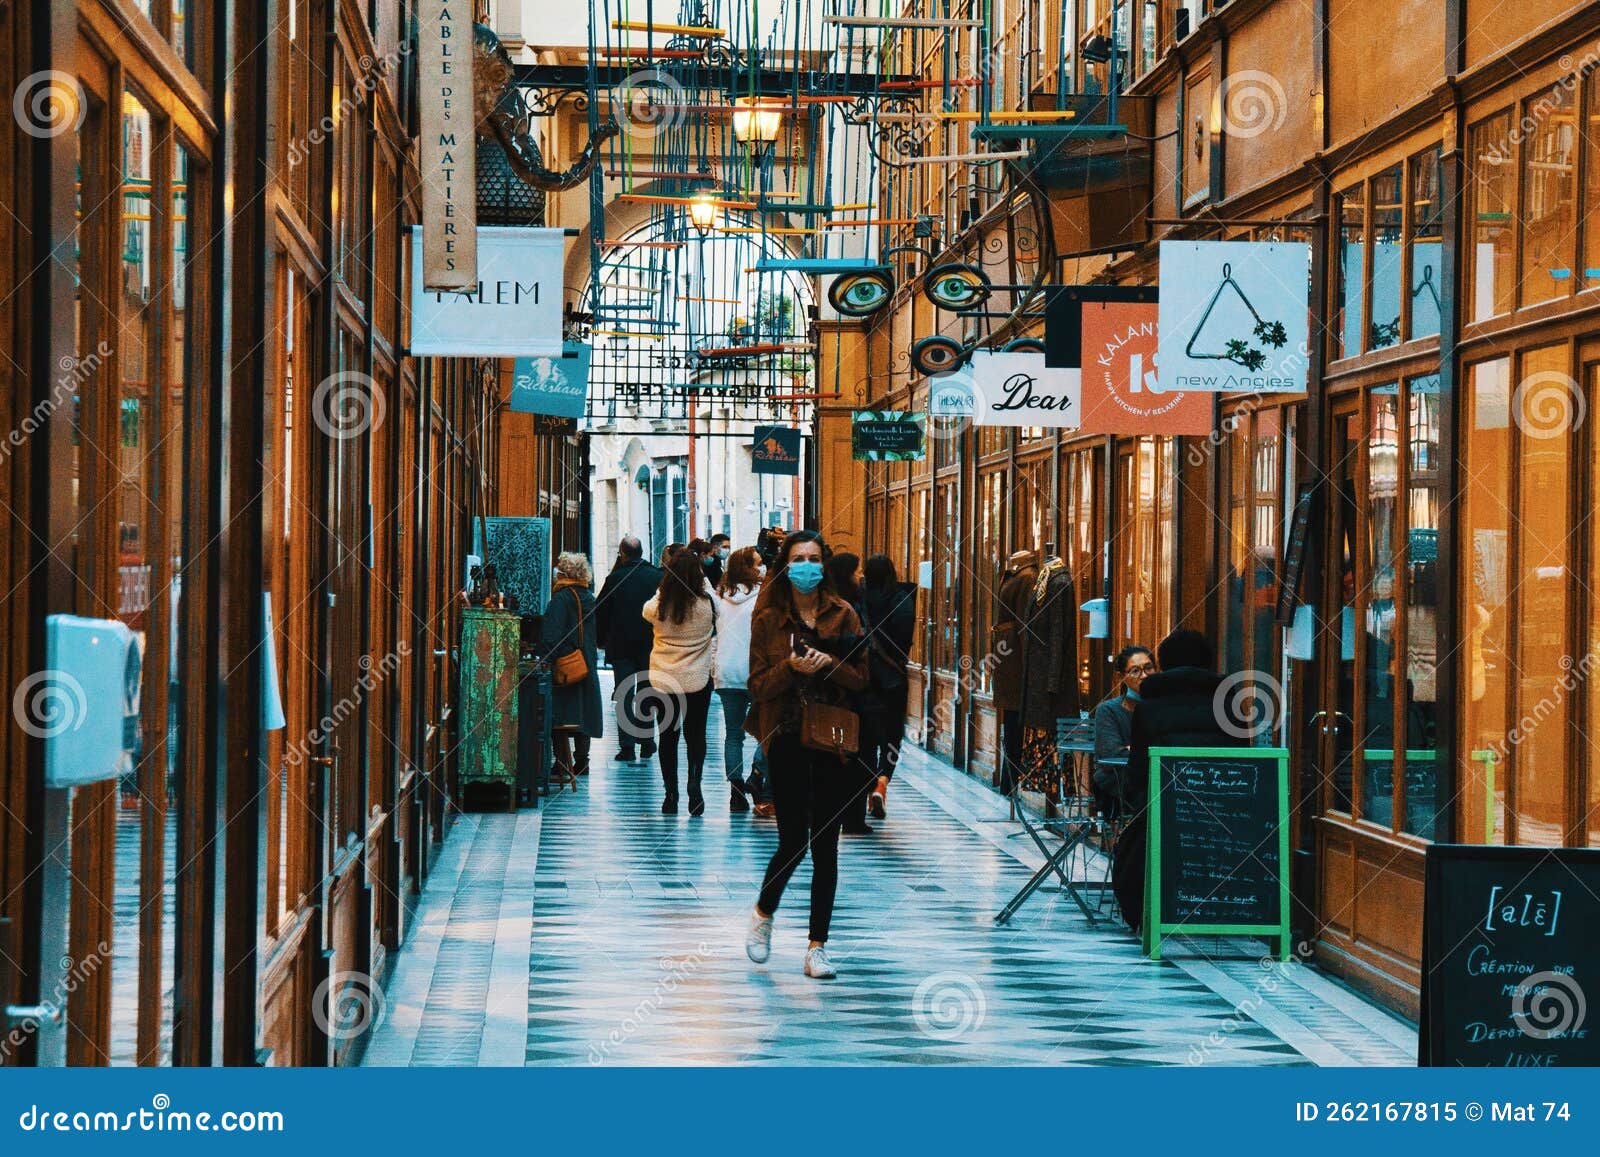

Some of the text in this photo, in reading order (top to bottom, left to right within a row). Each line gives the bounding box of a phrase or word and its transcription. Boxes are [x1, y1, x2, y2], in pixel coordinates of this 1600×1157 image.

[439, 0, 457, 271] ABLE DES MATIÈRES
[1098, 321, 1159, 367] KALAN
[516, 375, 584, 396] Rickshaw
[1175, 375, 1218, 386] new
[992, 373, 1072, 411] Dear
[1552, 965, 1575, 976] SUR
[1501, 984, 1549, 997] MESURE
[1547, 1029, 1588, 1040] VENTE
